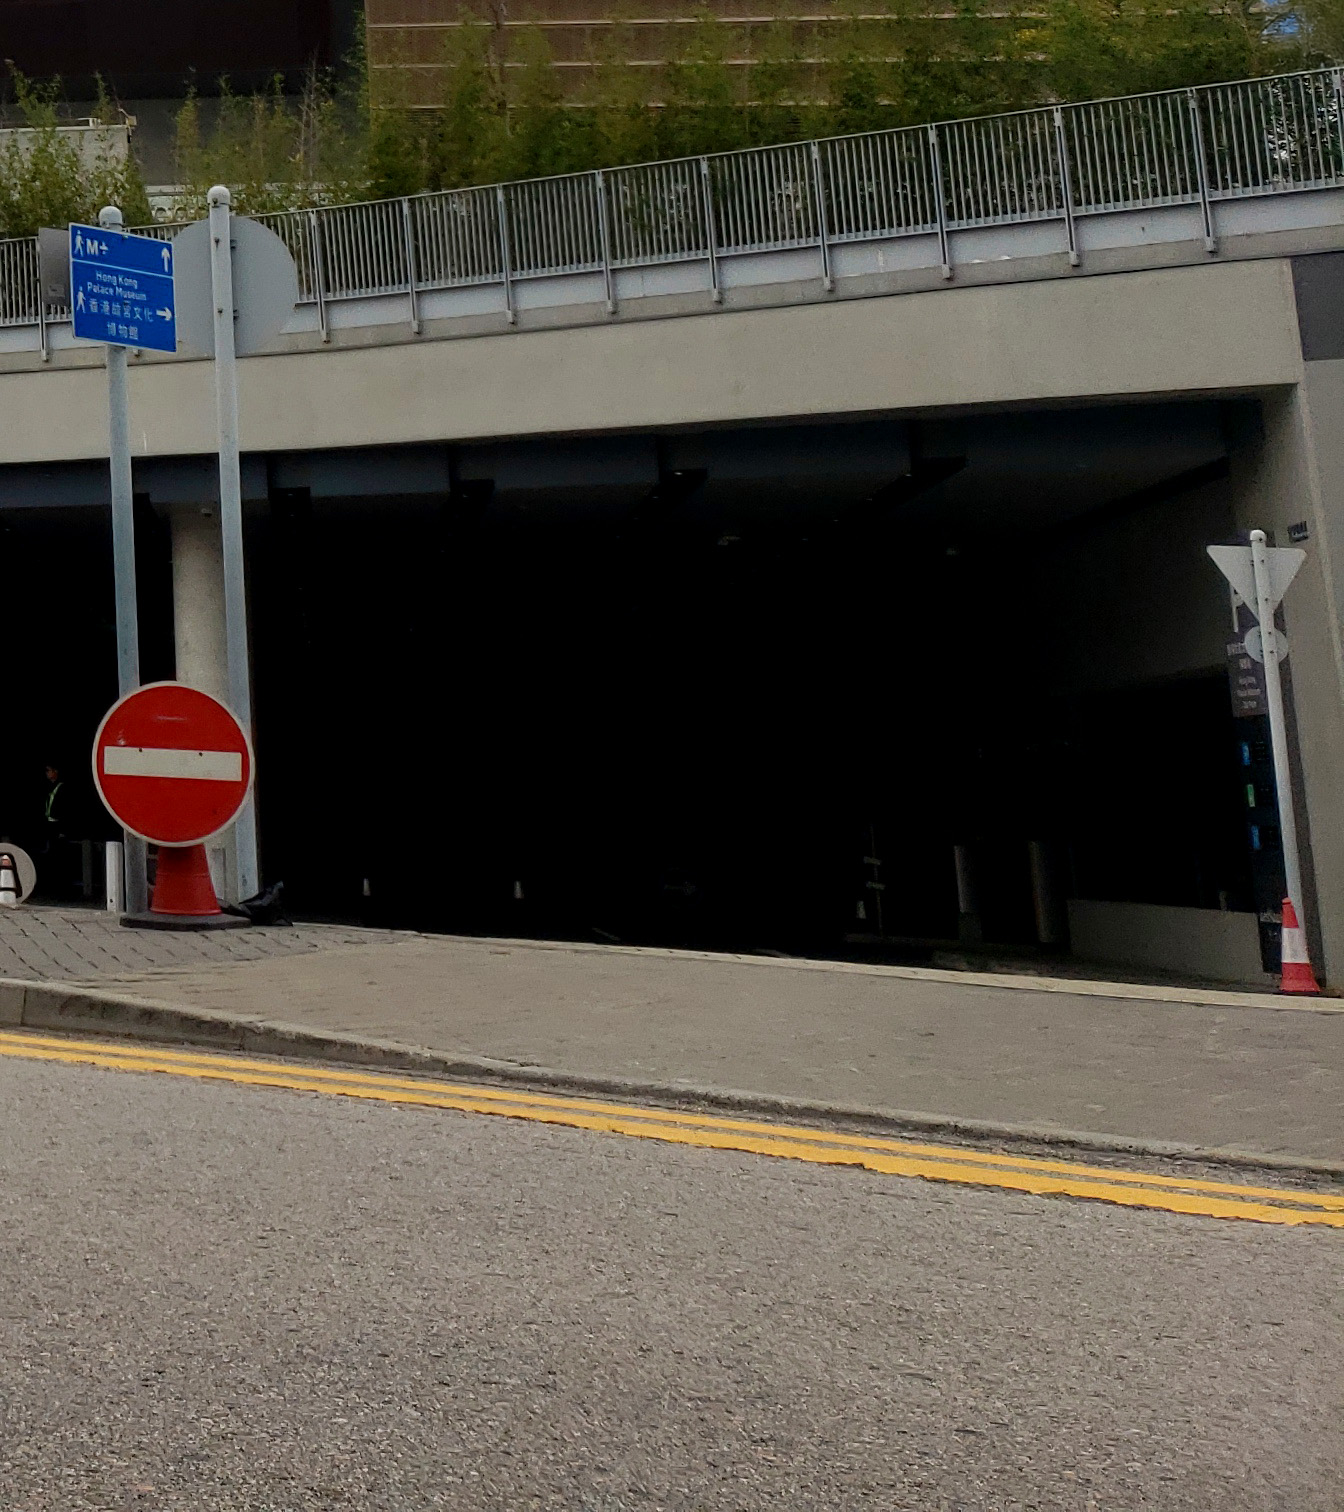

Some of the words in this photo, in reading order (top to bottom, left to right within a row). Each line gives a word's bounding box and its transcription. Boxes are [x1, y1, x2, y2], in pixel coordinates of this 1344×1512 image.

[95, 270, 118, 286] Hong
[118, 274, 138, 289] Kong
[87, 282, 115, 296] Palace
[115, 286, 147, 301] Museum
